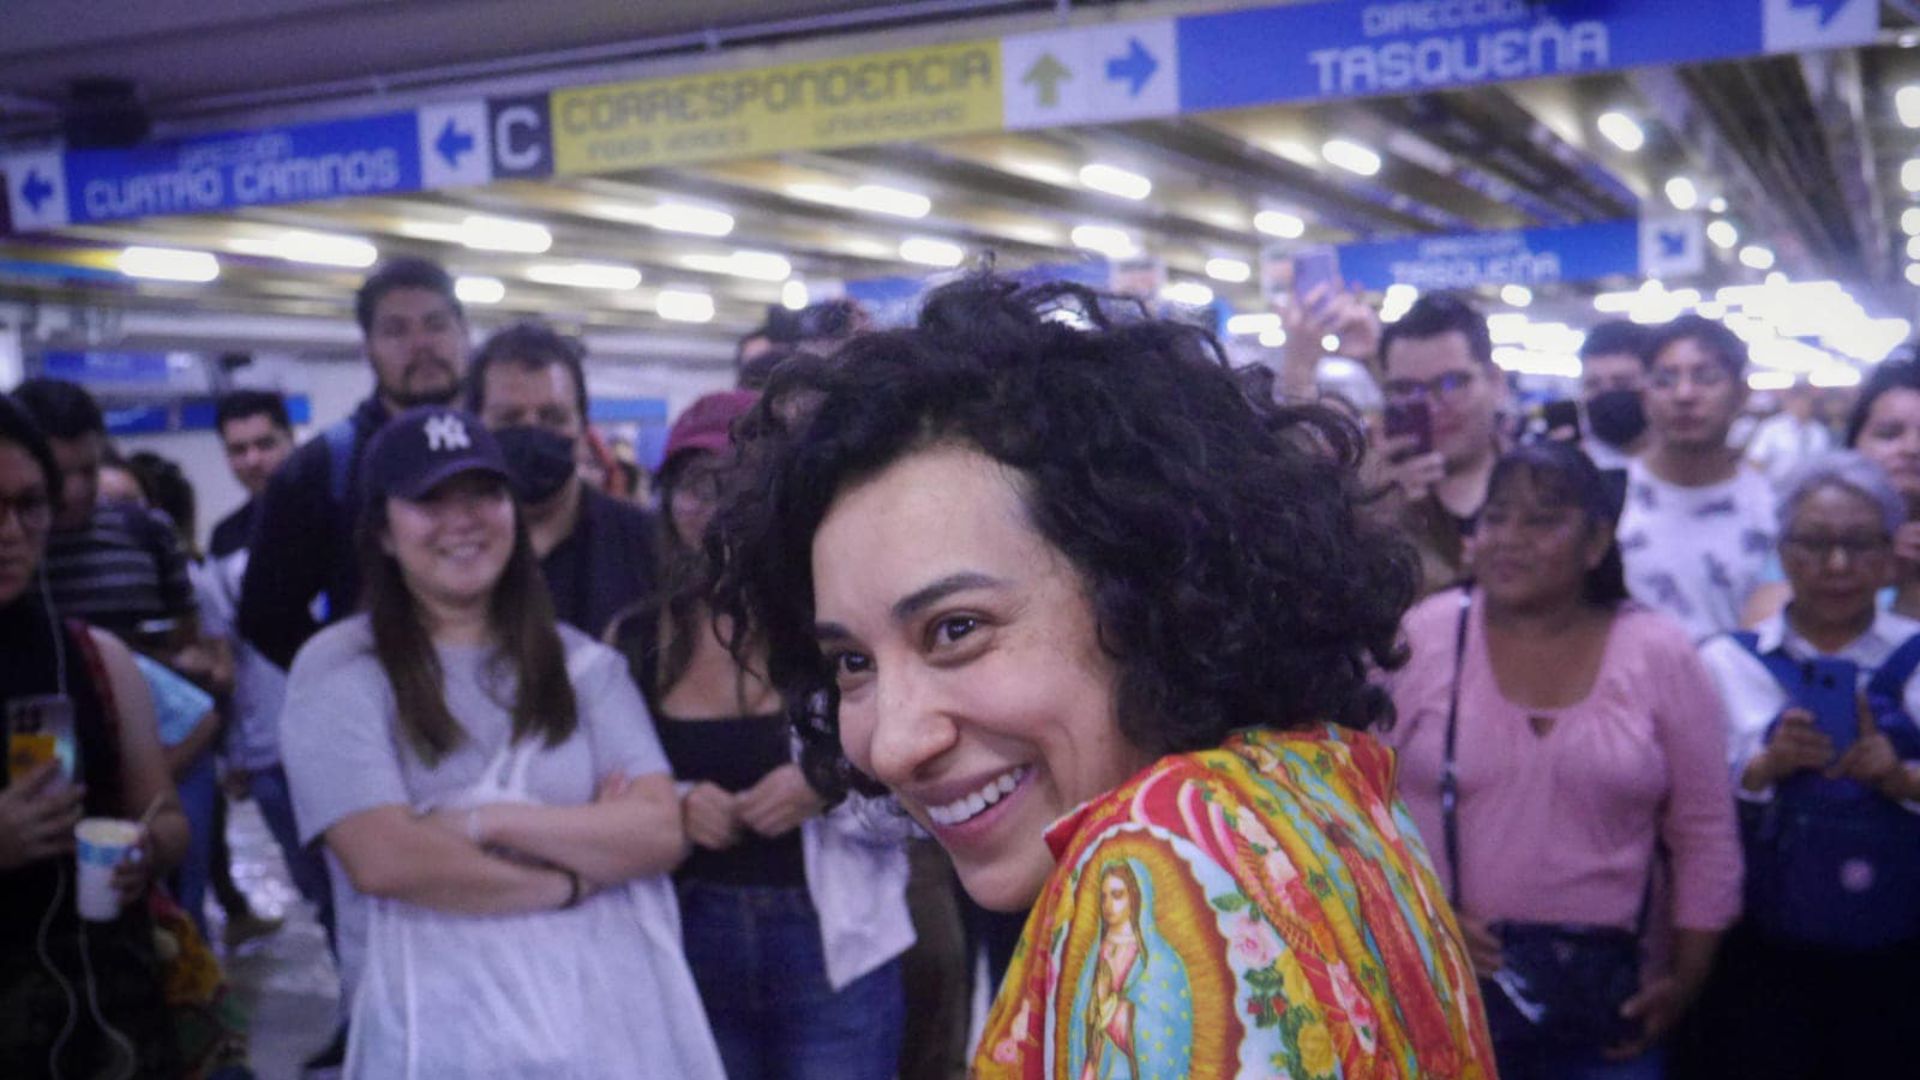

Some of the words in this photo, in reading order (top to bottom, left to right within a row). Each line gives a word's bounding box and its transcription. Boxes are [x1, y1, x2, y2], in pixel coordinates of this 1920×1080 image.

[562, 49, 992, 135] CORRESPONDENCIA
[1308, 16, 1609, 94] TASQUEÑA
[498, 106, 541, 169] C
